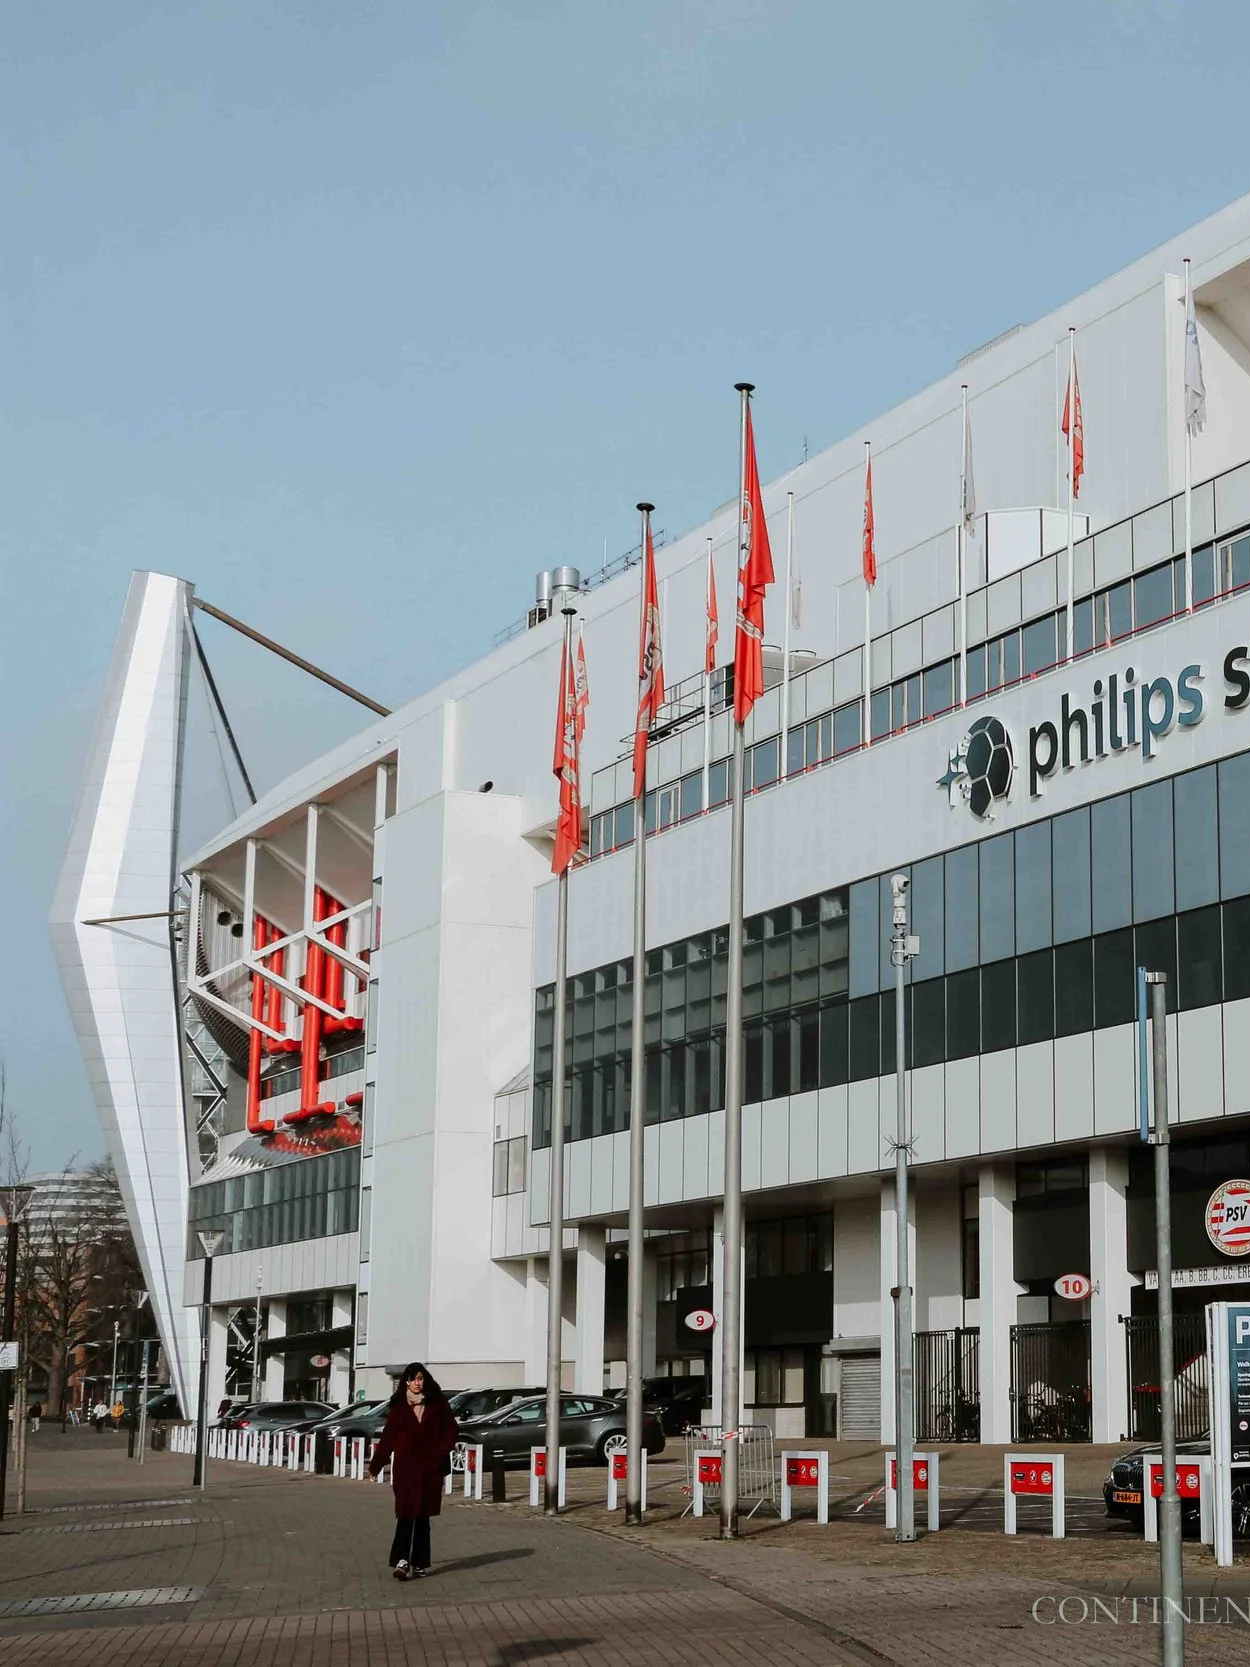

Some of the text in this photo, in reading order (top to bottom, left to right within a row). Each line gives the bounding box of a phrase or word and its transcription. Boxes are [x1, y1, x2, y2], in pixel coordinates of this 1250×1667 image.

[1029, 665, 1205, 796] philips
[1225, 1205, 1248, 1223] PSV
[1062, 1280, 1083, 1294] 10
[696, 1315, 705, 1327] 9
